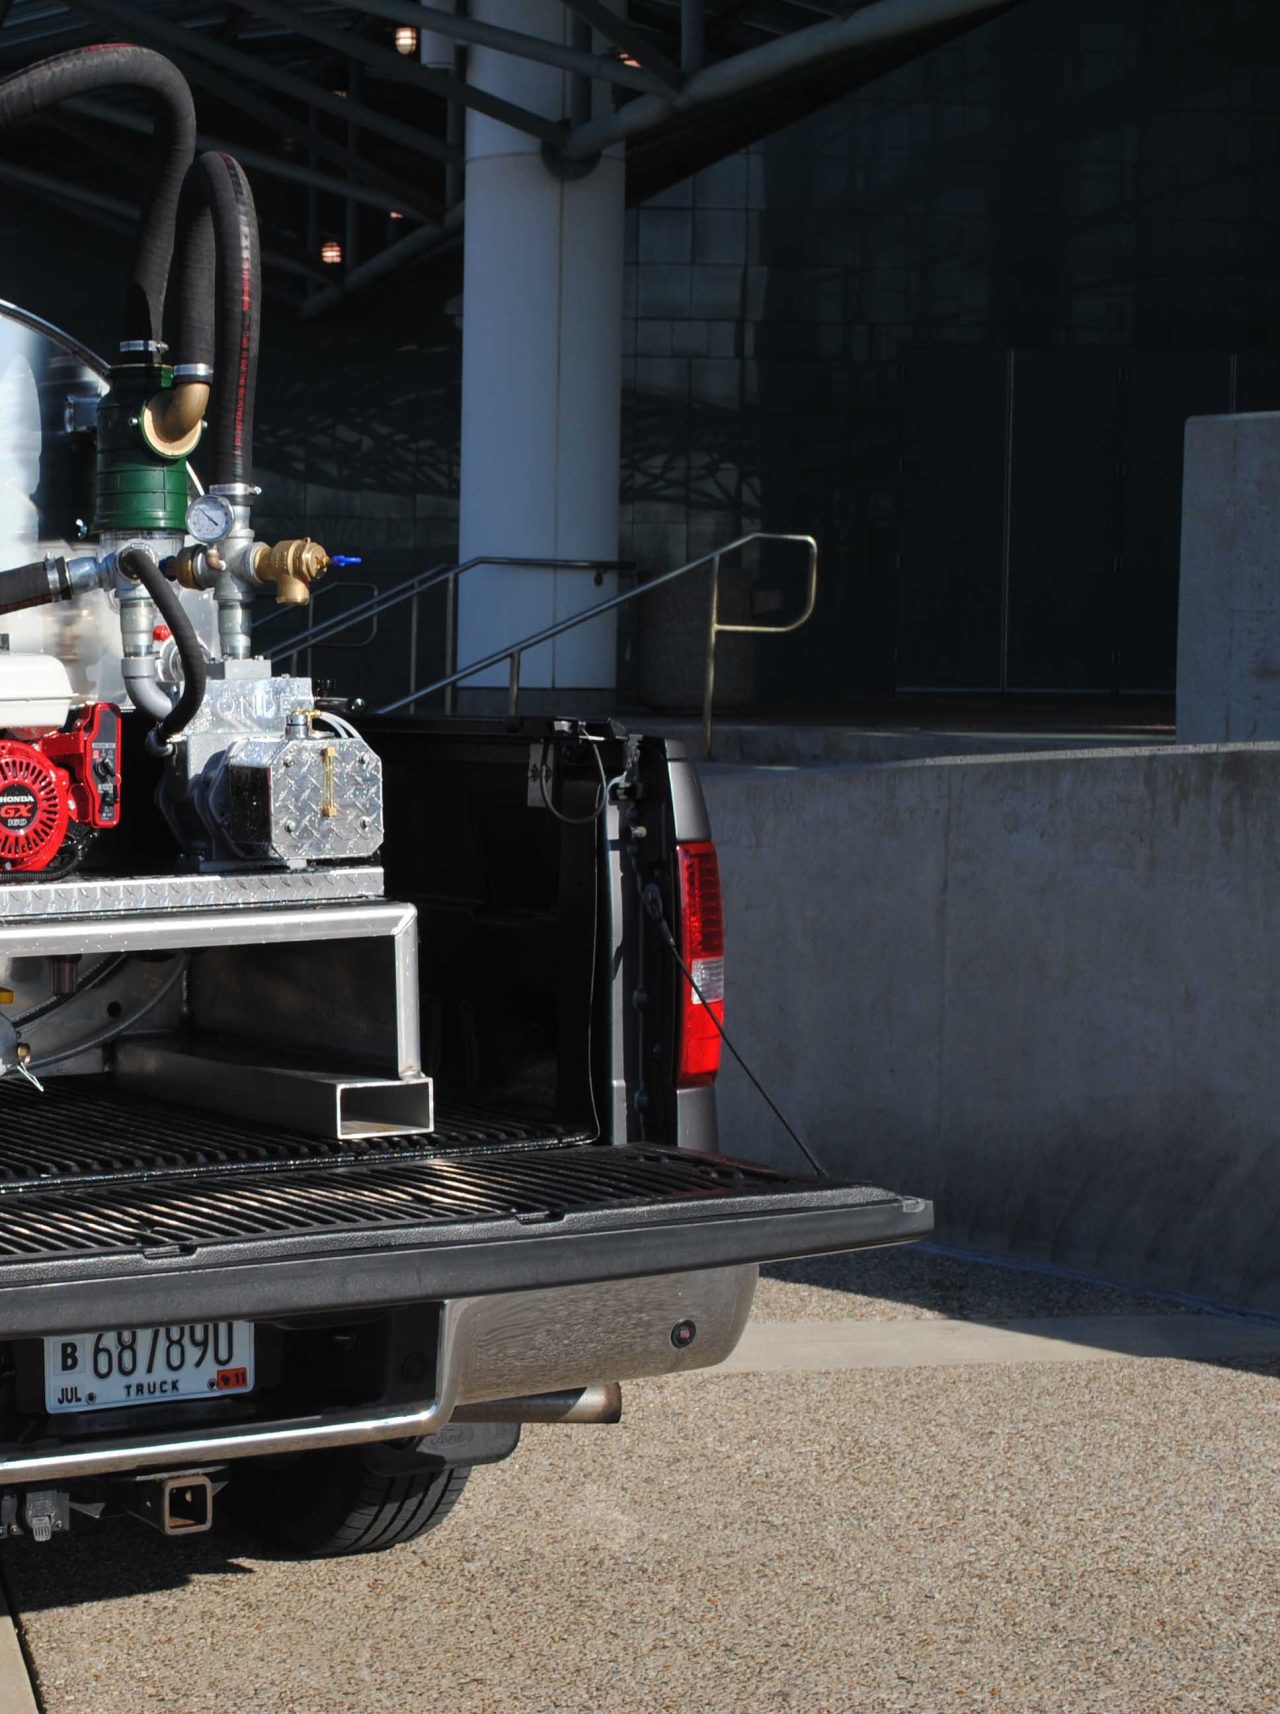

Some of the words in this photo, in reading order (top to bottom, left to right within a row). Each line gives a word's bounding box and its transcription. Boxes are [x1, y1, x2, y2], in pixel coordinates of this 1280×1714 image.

[204, 694, 293, 719] ONDE
[0, 795, 34, 803] HONDA
[0, 804, 32, 818] GX
[61, 1342, 79, 1372] B
[57, 1387, 82, 1404] JUL
[124, 1379, 180, 1397] TRUCK
